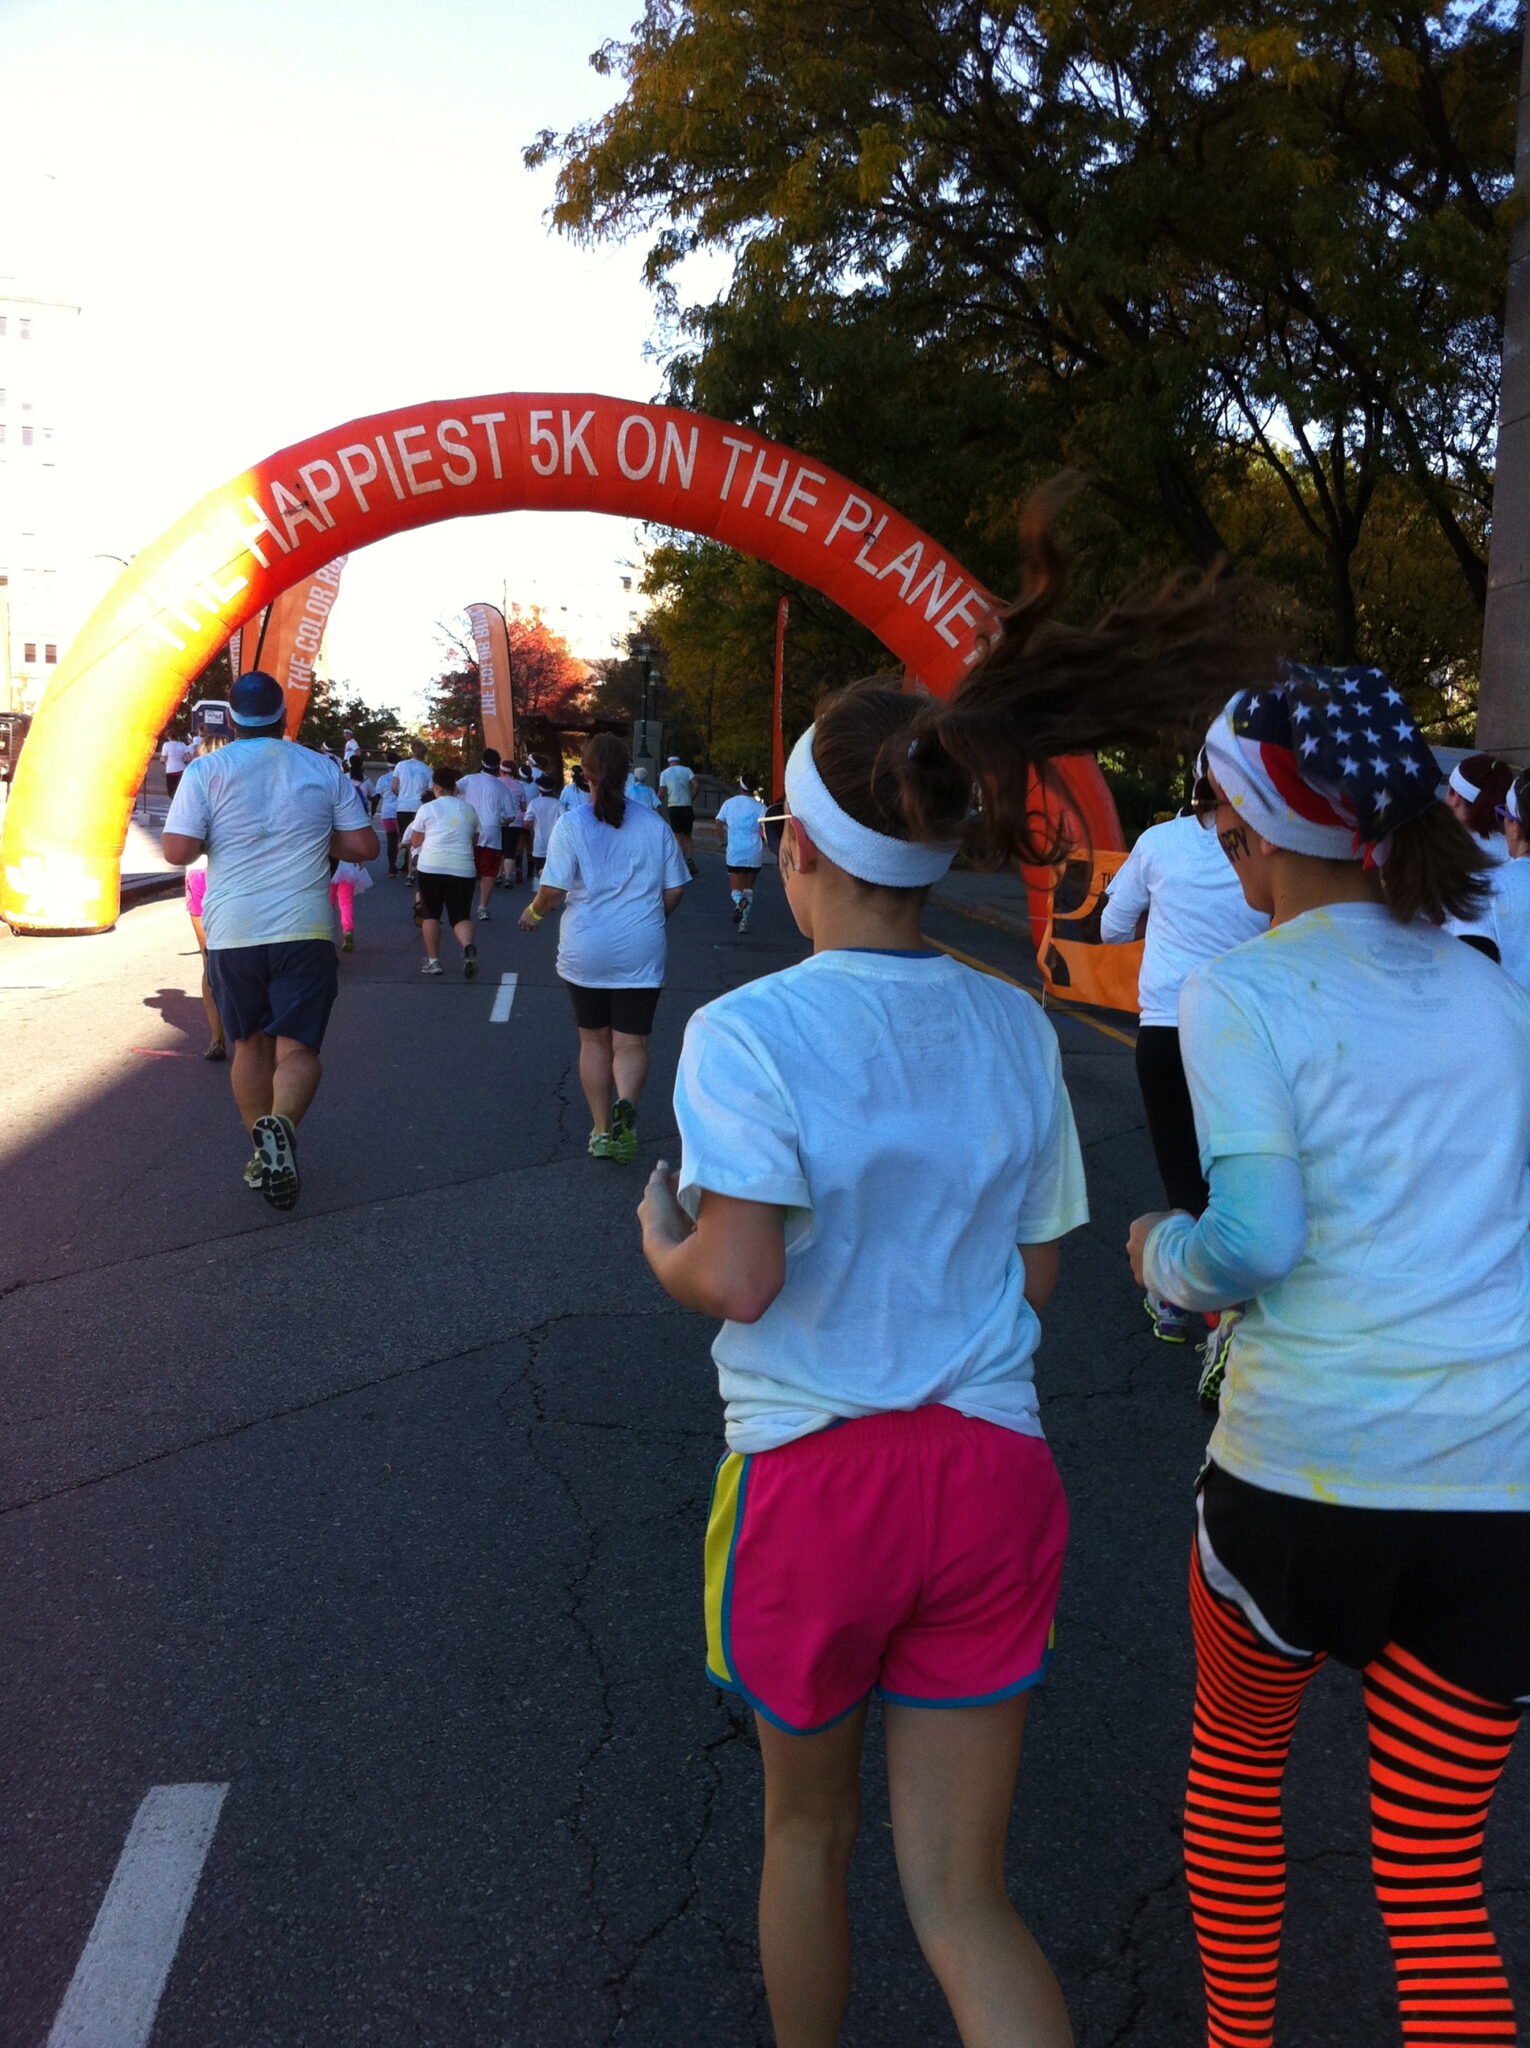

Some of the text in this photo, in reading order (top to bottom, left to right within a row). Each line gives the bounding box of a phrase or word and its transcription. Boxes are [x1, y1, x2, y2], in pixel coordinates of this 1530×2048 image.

[222, 411, 506, 569] HAPPIEST
[529, 409, 599, 477] 5K
[616, 415, 699, 490] ON
[719, 436, 826, 533] THE
[288, 553, 348, 691] THE COLOR RU
[480, 689, 497, 717] THE
